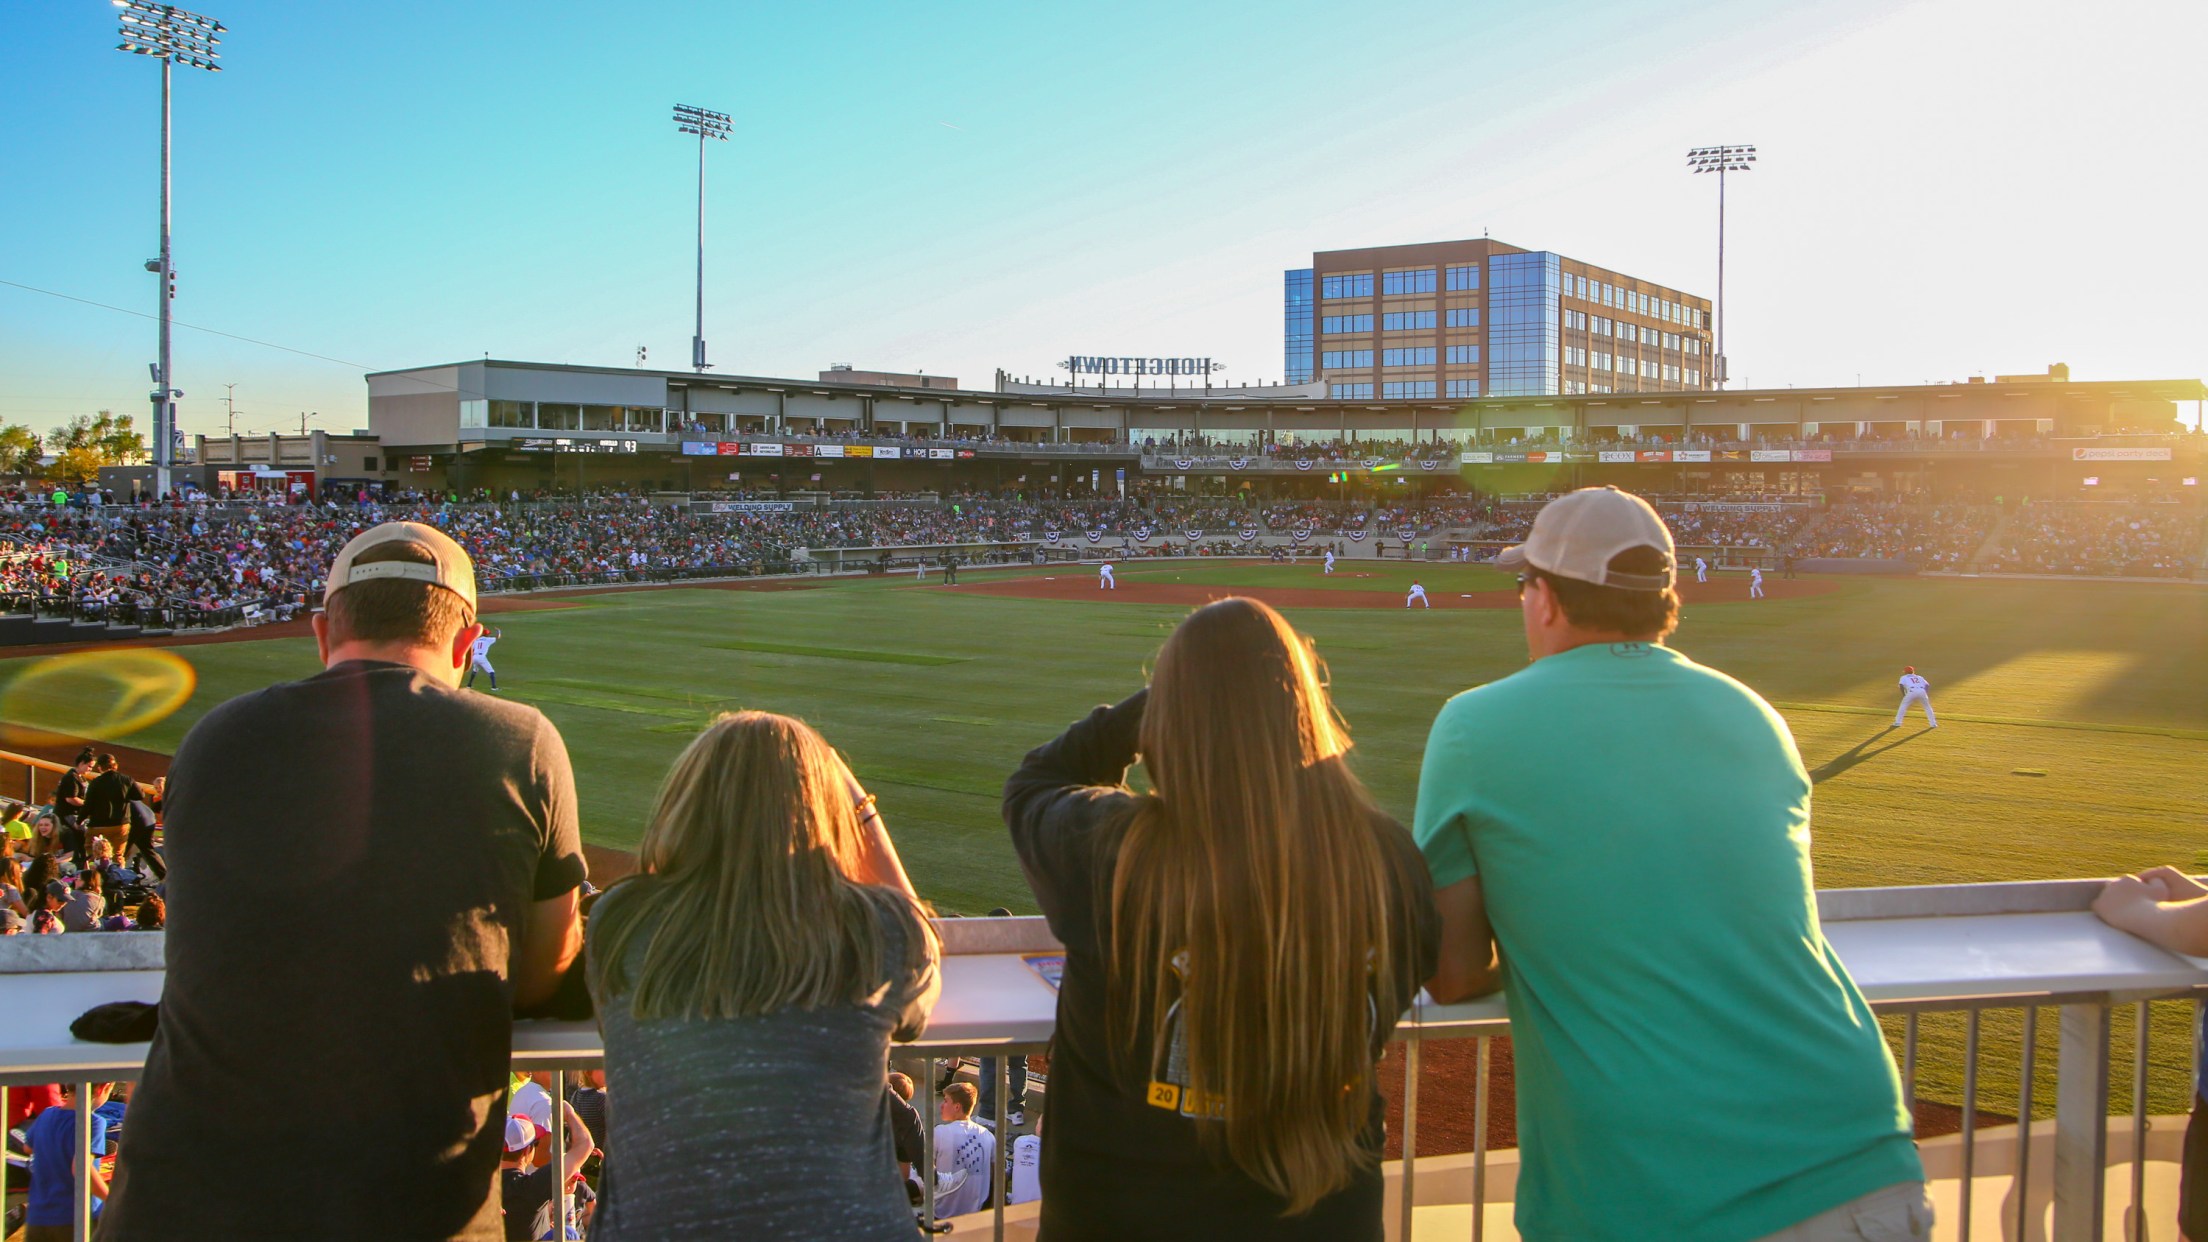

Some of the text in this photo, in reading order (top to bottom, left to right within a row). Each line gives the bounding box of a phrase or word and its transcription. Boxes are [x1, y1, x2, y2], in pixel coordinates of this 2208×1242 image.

[624, 440, 637, 453] 93
[913, 448, 927, 457] HOPE
[1610, 452, 1632, 460] COX
[2088, 450, 2115, 458] pepsi
[2117, 450, 2143, 458] party
[763, 503, 792, 511] SUPPLY
[1702, 505, 1743, 513] WELDING
[1744, 505, 1780, 513] SUPPLY
[1155, 1086, 1174, 1104] 20
